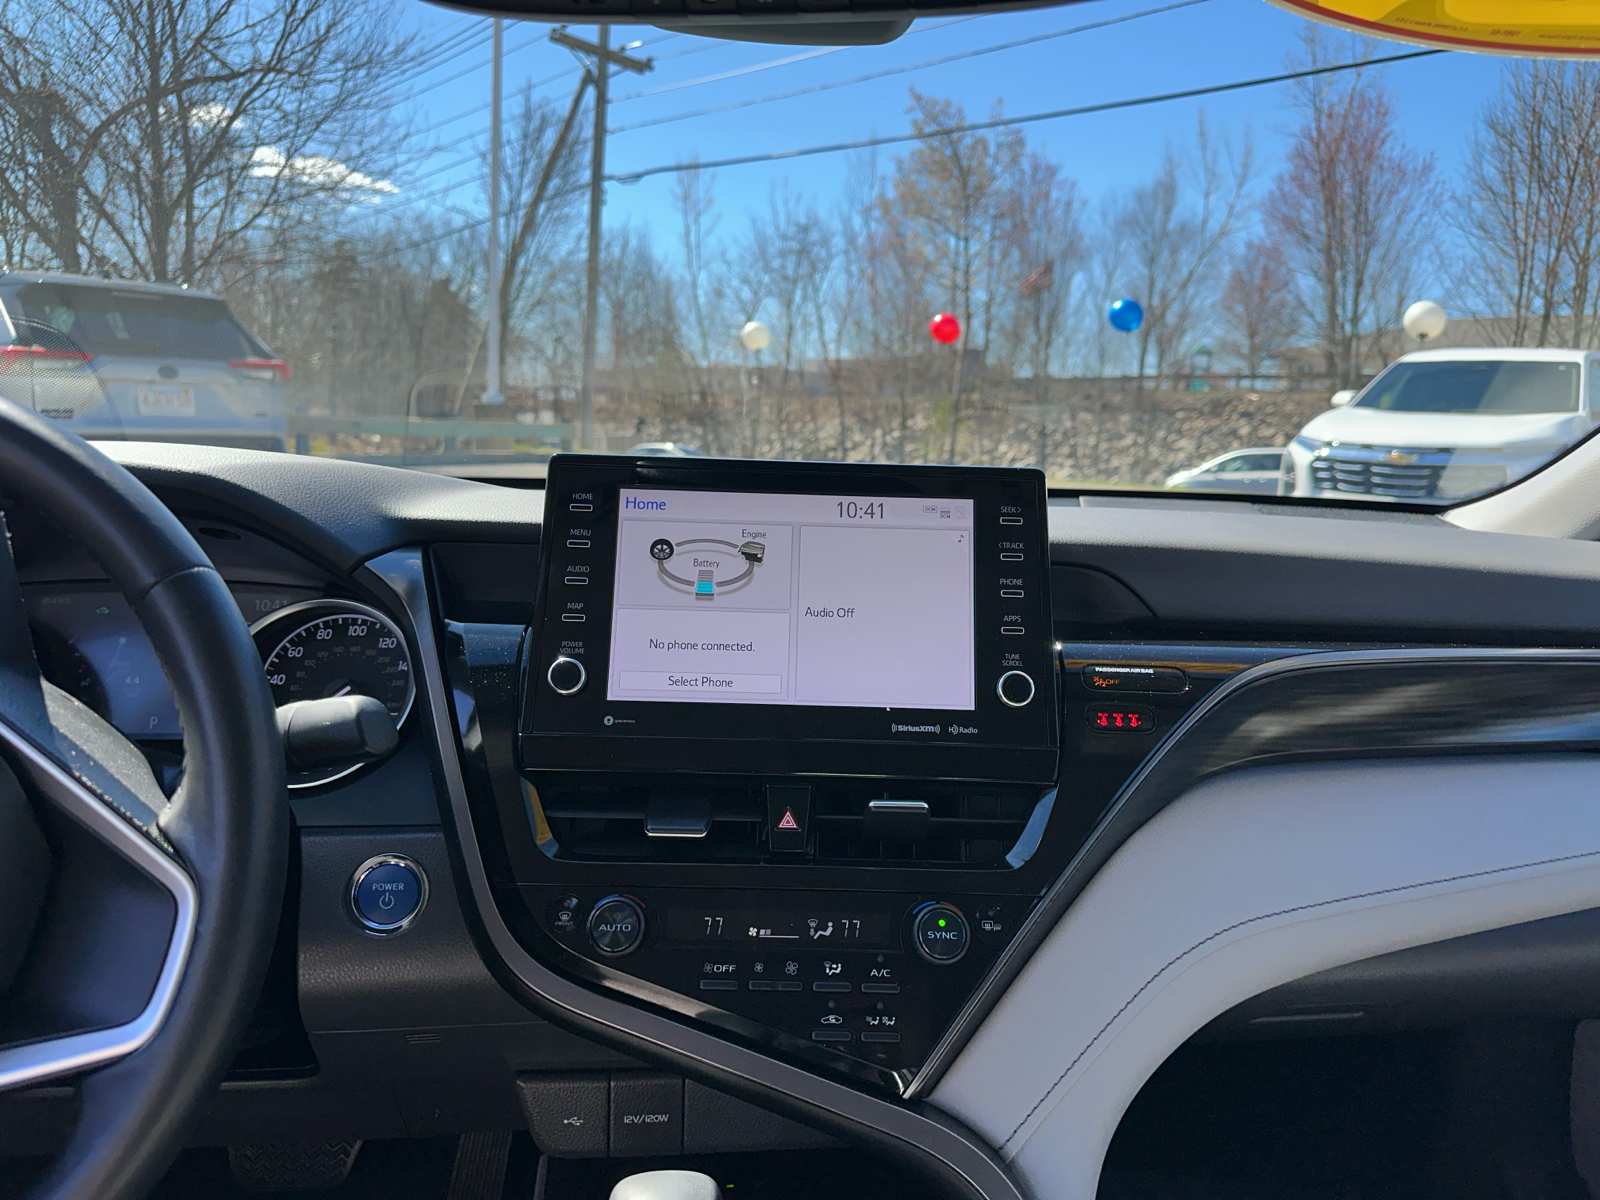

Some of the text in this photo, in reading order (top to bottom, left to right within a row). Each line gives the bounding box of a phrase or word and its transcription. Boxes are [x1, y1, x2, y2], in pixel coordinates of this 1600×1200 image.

[625, 496, 667, 511] Home
[836, 501, 884, 520] 10:41
[741, 529, 767, 539] Engine
[566, 565, 590, 573] AUDIO
[693, 558, 720, 569] Battery
[1000, 578, 1023, 586] PHONE
[567, 602, 584, 610] MAP
[804, 607, 855, 618] Audio Off
[1003, 615, 1021, 623] APPS
[316, 629, 333, 640] 80
[347, 625, 367, 636] 100
[378, 637, 397, 649] 120
[649, 639, 756, 652] No phone connected.
[287, 646, 304, 657] 60
[560, 647, 585, 655] VOLUME
[398, 660, 408, 671] 14
[125, 676, 140, 685] 4.4
[269, 674, 286, 685] 40
[668, 676, 734, 688] Select Phone
[149, 716, 158, 729] P
[959, 726, 978, 734] Radio
[372, 882, 405, 891] POWER
[598, 922, 632, 933] AUTO
[704, 916, 724, 936] 77
[841, 919, 861, 938] 77
[927, 930, 958, 940] SYNC
[713, 964, 736, 973] OFF
[870, 968, 892, 978] A/C
[623, 1113, 670, 1124] 12V/120W
